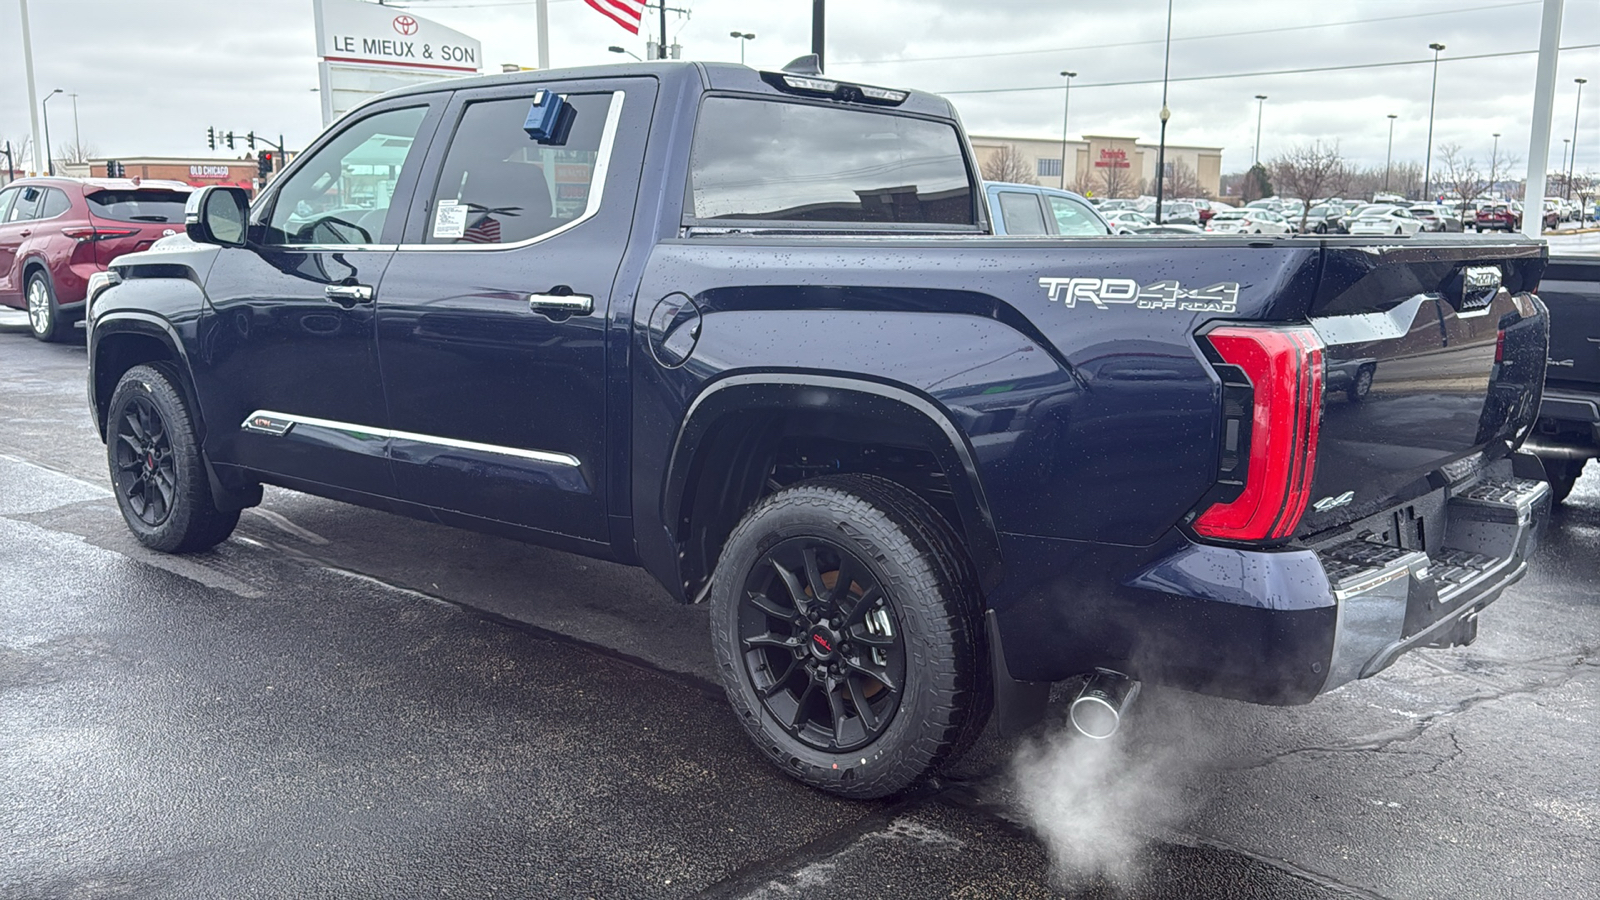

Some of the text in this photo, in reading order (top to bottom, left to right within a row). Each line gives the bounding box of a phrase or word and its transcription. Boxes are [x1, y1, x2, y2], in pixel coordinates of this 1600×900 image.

[333, 35, 476, 63] LE MIEUX & SON
[190, 165, 229, 176] OLD CHICAGO
[1038, 277, 1240, 310] TRD 4x4
[1137, 300, 1237, 313] OFF ROAD
